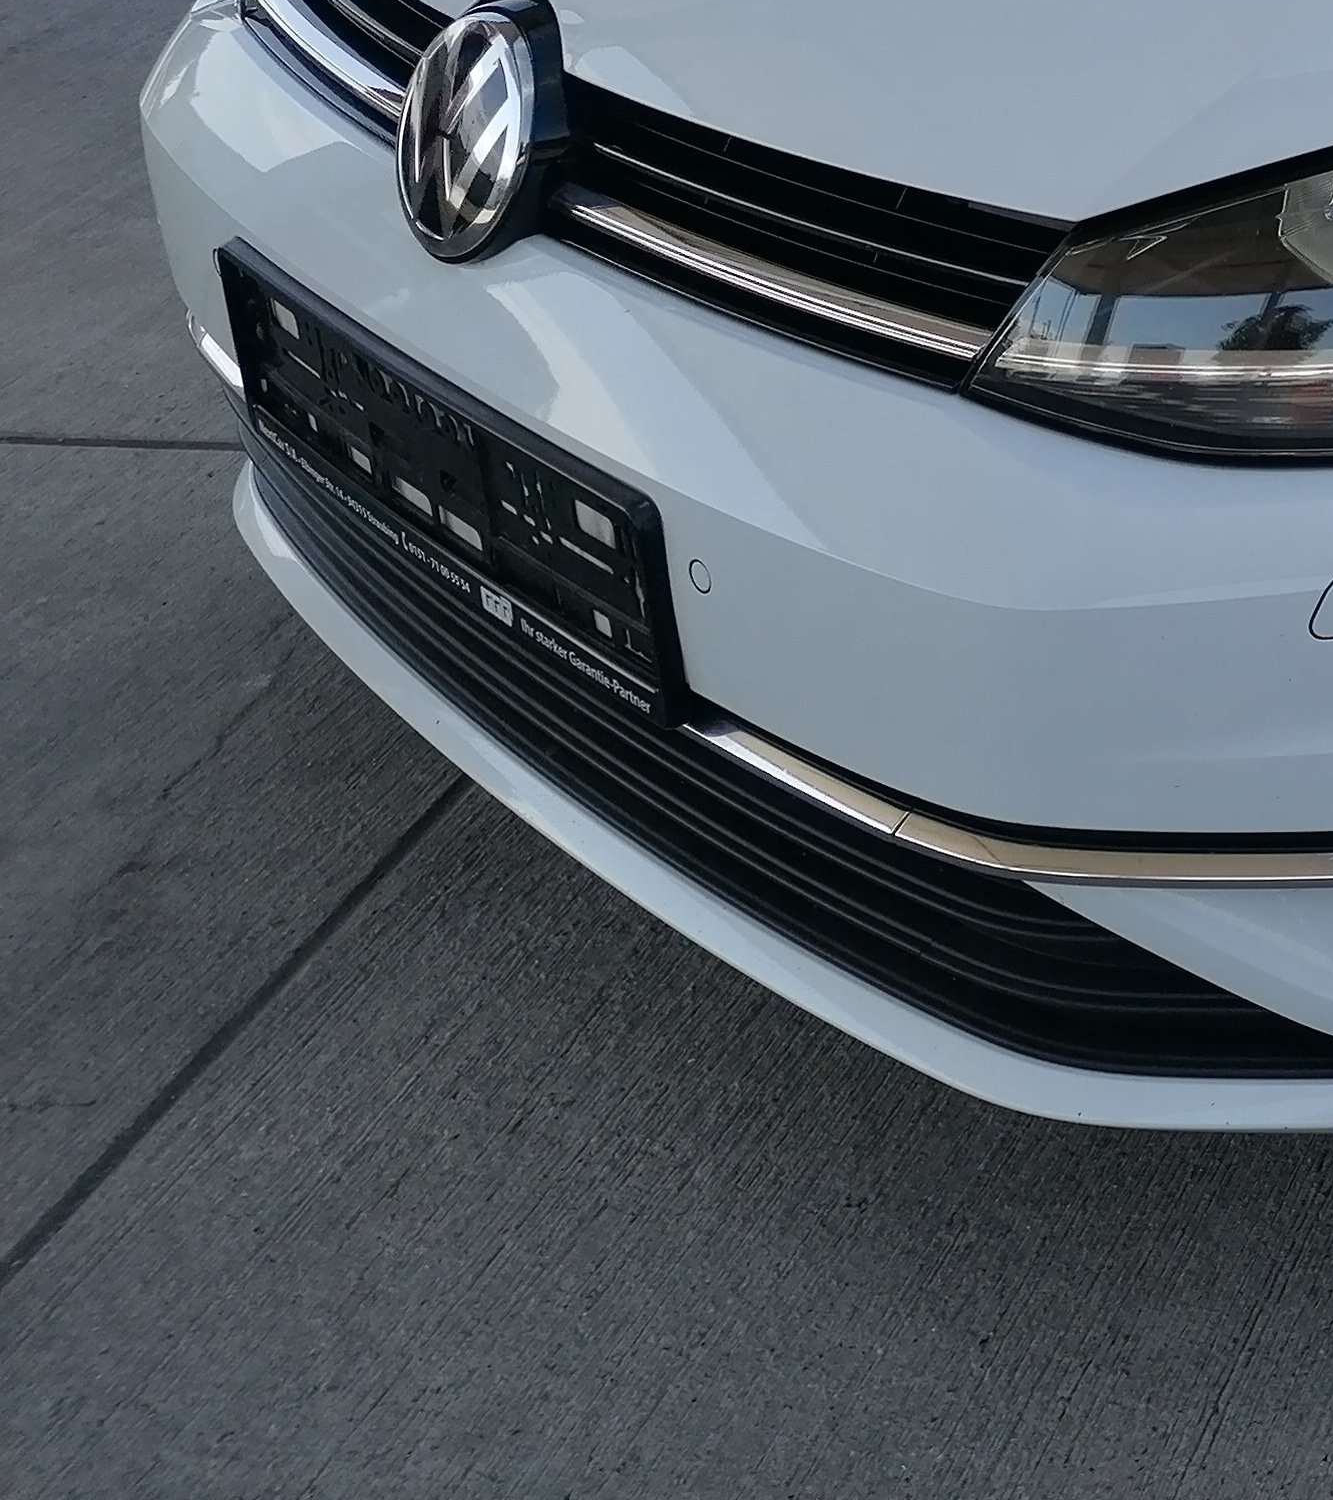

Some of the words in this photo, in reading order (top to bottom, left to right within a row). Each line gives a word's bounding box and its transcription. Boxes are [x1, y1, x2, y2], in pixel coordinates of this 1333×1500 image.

[520, 617, 535, 638] Ihr
[535, 630, 568, 660] starker
[568, 650, 651, 714] Garantie-Partner
